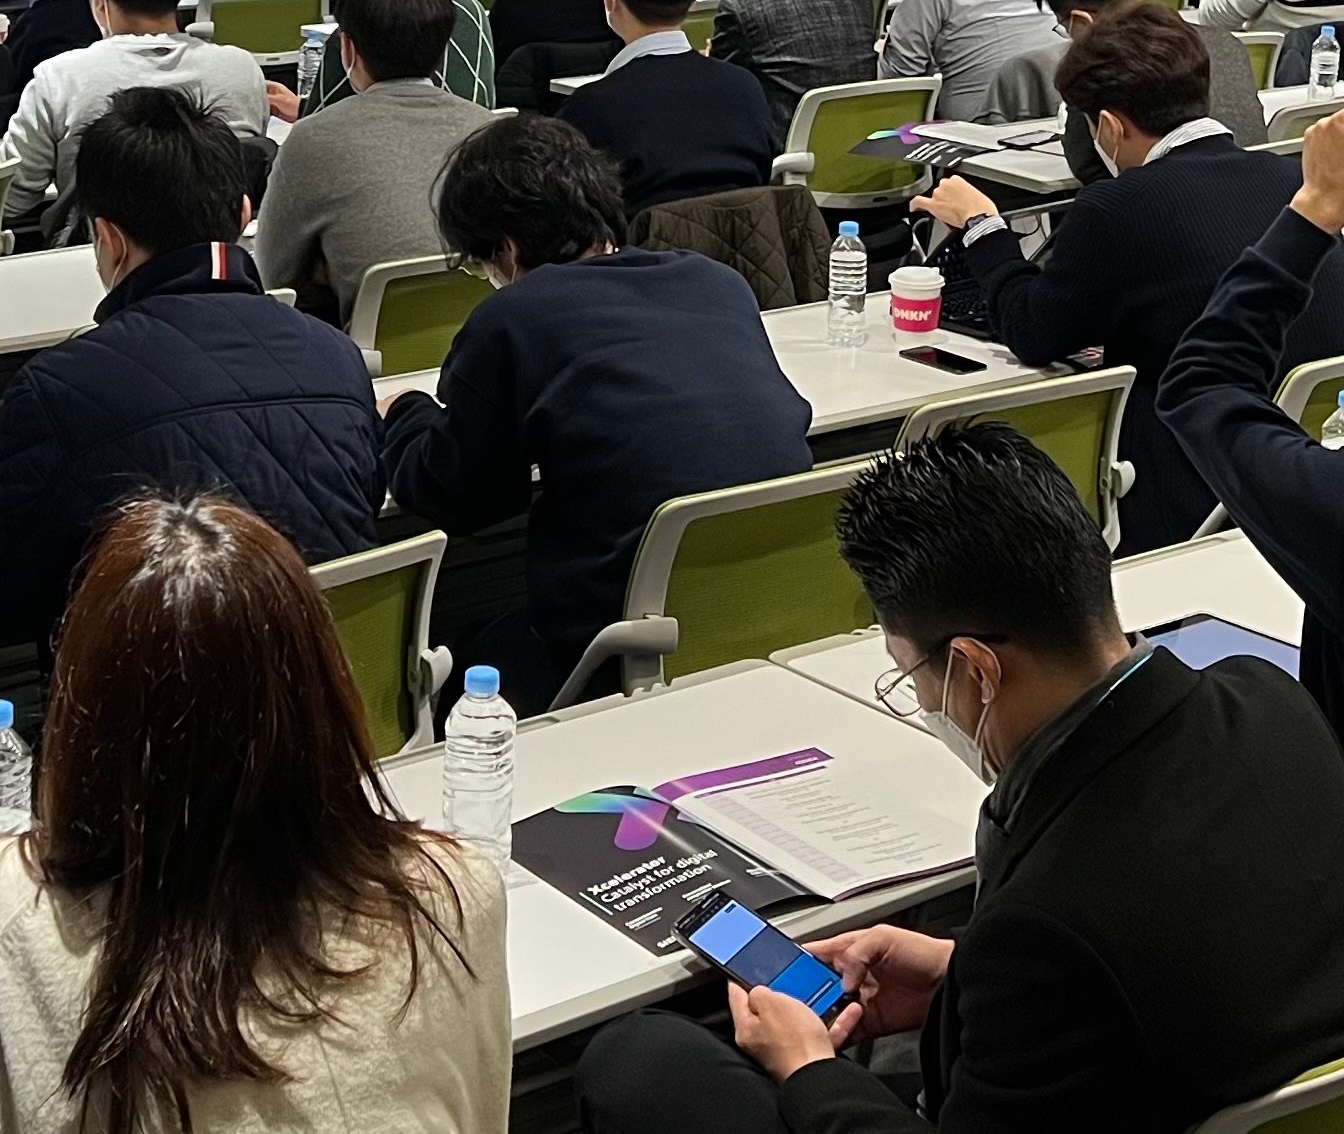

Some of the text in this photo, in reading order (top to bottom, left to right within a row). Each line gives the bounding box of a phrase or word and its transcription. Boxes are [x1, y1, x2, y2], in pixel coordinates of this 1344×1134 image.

[587, 855, 666, 896] Xcelerator
[600, 874, 657, 903] Catalyst
[653, 864, 676, 878] for
[675, 849, 719, 870] digital
[613, 864, 713, 912] transformation
